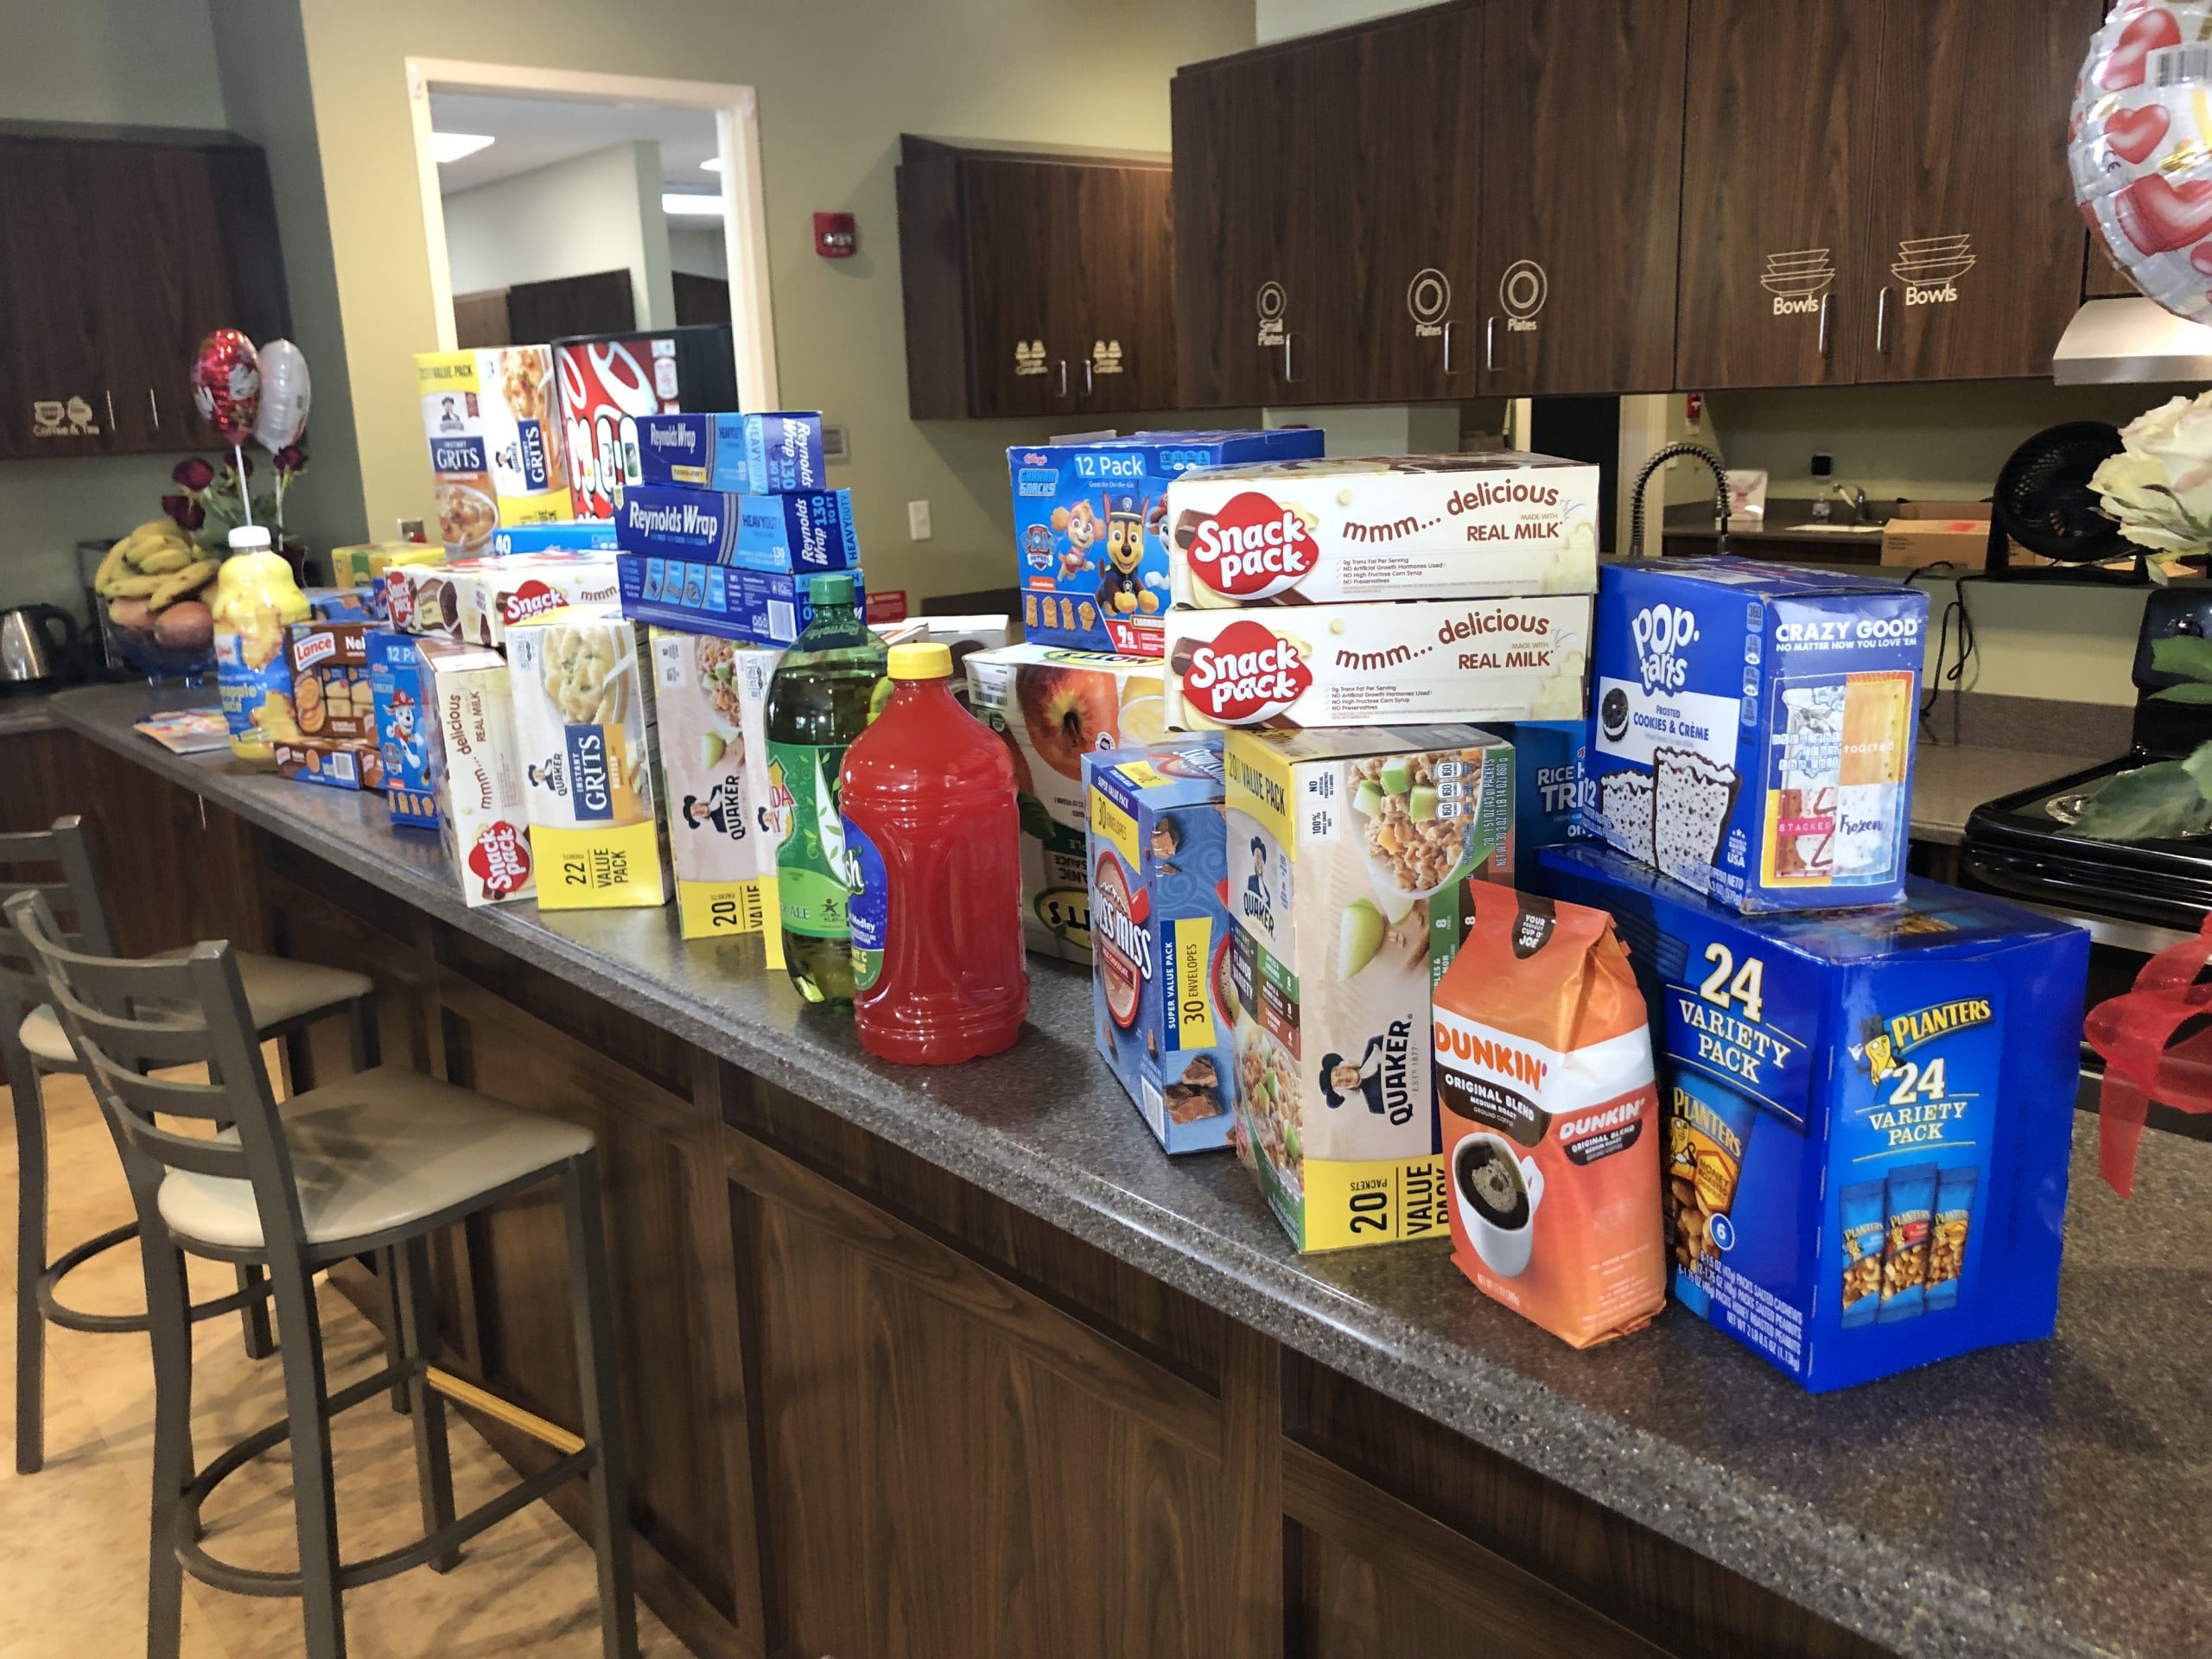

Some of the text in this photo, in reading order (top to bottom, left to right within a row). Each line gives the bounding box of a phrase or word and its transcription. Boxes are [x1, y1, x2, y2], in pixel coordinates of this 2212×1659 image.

[1773, 296, 1819, 315] Bowls
[1906, 283, 1958, 305] Bowls
[1415, 324, 1442, 337] Plates
[1508, 319, 1536, 331] Plates
[454, 365, 473, 378] PACK
[650, 422, 696, 454] Reynolds Wrap
[437, 447, 480, 470] GRITS
[527, 426, 545, 484] GRITS
[779, 418, 797, 490] Wrap 130
[796, 421, 814, 488] Reynolds
[1075, 455, 1144, 477] 12 Pack
[1446, 478, 1560, 516] delicious
[629, 500, 718, 544] Reynolds Wrap
[794, 499, 816, 563] Reynolds
[811, 495, 830, 566] Wrap 130
[1194, 509, 1306, 563] Snack
[1466, 524, 1510, 543] REAL
[495, 534, 512, 553] 40
[1219, 544, 1306, 588] pack
[506, 588, 563, 620] Snack
[1437, 607, 1550, 645] delicious
[1775, 618, 1918, 643] CRAZY GOOD
[296, 638, 333, 661] Lance
[386, 646, 400, 663] 12
[1776, 643, 1792, 652] NO
[1793, 641, 1829, 652] MATTER
[1831, 640, 1855, 650] HOW
[1857, 640, 1877, 649] YOU
[1878, 638, 1901, 647] LOVE
[1189, 636, 1300, 690] Snack
[1458, 652, 1502, 671] REAL
[1211, 673, 1297, 714] pack
[448, 693, 473, 755] delicious
[473, 690, 486, 743] REAL MILK
[1633, 711, 1668, 733] COOKIES
[1669, 721, 1676, 734] &
[1678, 721, 1710, 741] CRÈME
[1656, 704, 1681, 719] FROSTED
[553, 753, 569, 797] QUAKER
[572, 753, 584, 793] INSTANT
[578, 734, 608, 811] GRITS
[1441, 764, 1452, 773] 160
[1483, 759, 1495, 788] PACKETS
[1538, 766, 1574, 786] RICE
[1108, 782, 1130, 810] VALUE PACK
[1241, 760, 1264, 801] VALUE
[1265, 776, 1287, 817] PACK
[1308, 780, 1319, 792] NO
[1441, 784, 1452, 796] 160
[1583, 777, 1597, 808] 12
[724, 773, 747, 841] QUAKER
[1098, 797, 1107, 830] 30
[1441, 804, 1452, 817] 160
[1312, 810, 1321, 835] 100%
[1778, 822, 1833, 833] STACKED
[1840, 814, 1884, 836] Frozen
[478, 828, 514, 890] Snack
[496, 827, 529, 875] pack
[1727, 851, 1746, 868] USA
[565, 861, 588, 886] 22
[594, 847, 613, 889] VALUE
[612, 849, 629, 884] PACK
[711, 900, 738, 927] 20
[791, 906, 810, 920] ALE
[851, 915, 876, 934] Medley
[1243, 891, 1275, 940] QUAKER
[1435, 918, 1447, 929] 8
[1464, 915, 1476, 925] 8
[1522, 921, 1544, 931] PERFECT
[1525, 914, 1546, 927] YOUR
[1518, 935, 1540, 949] JOE
[1521, 927, 1535, 937] CUP
[1116, 914, 1154, 982] MISS
[1233, 949, 1252, 982] FLAVOR
[1164, 941, 1177, 1029] SUPER VALUE PACK
[1183, 943, 1205, 1026] 30 ENVELOPES
[1232, 963, 1254, 1001] VARIETY
[1700, 942, 1764, 1023] 24
[1678, 998, 1791, 1070] VARIETY
[1891, 999, 1992, 1048] PLANTERS
[1433, 1020, 1548, 1092] DUNKIN'
[1697, 1033, 1762, 1084] PACK
[1386, 1020, 1414, 1126] QUAKER
[1889, 1058, 1945, 1105] 24
[1445, 1073, 1535, 1122] ORIGINAL BLEND
[1470, 1096, 1517, 1121] MEDIUM ROAST
[1473, 1107, 1497, 1121] GROUND
[1559, 1097, 1646, 1141] DUNKIN'
[1673, 1086, 1742, 1158] PLANTERS
[1868, 1101, 1968, 1130] VARIETY
[1571, 1124, 1636, 1154] ORIGINAL BLEND
[1605, 1137, 1623, 1148] ROAST
[1887, 1122, 1945, 1147] PACK
[1699, 1158, 1729, 1185] HONEY
[1349, 1192, 1388, 1234] 20
[1407, 1162, 1433, 1236] VALUE
[1716, 1223, 1726, 1239] 6
[1844, 1221, 1885, 1241] PLANTERS
[1890, 1209, 1931, 1228] PLANTERS
[1750, 1311, 1775, 1338] ROASTED
